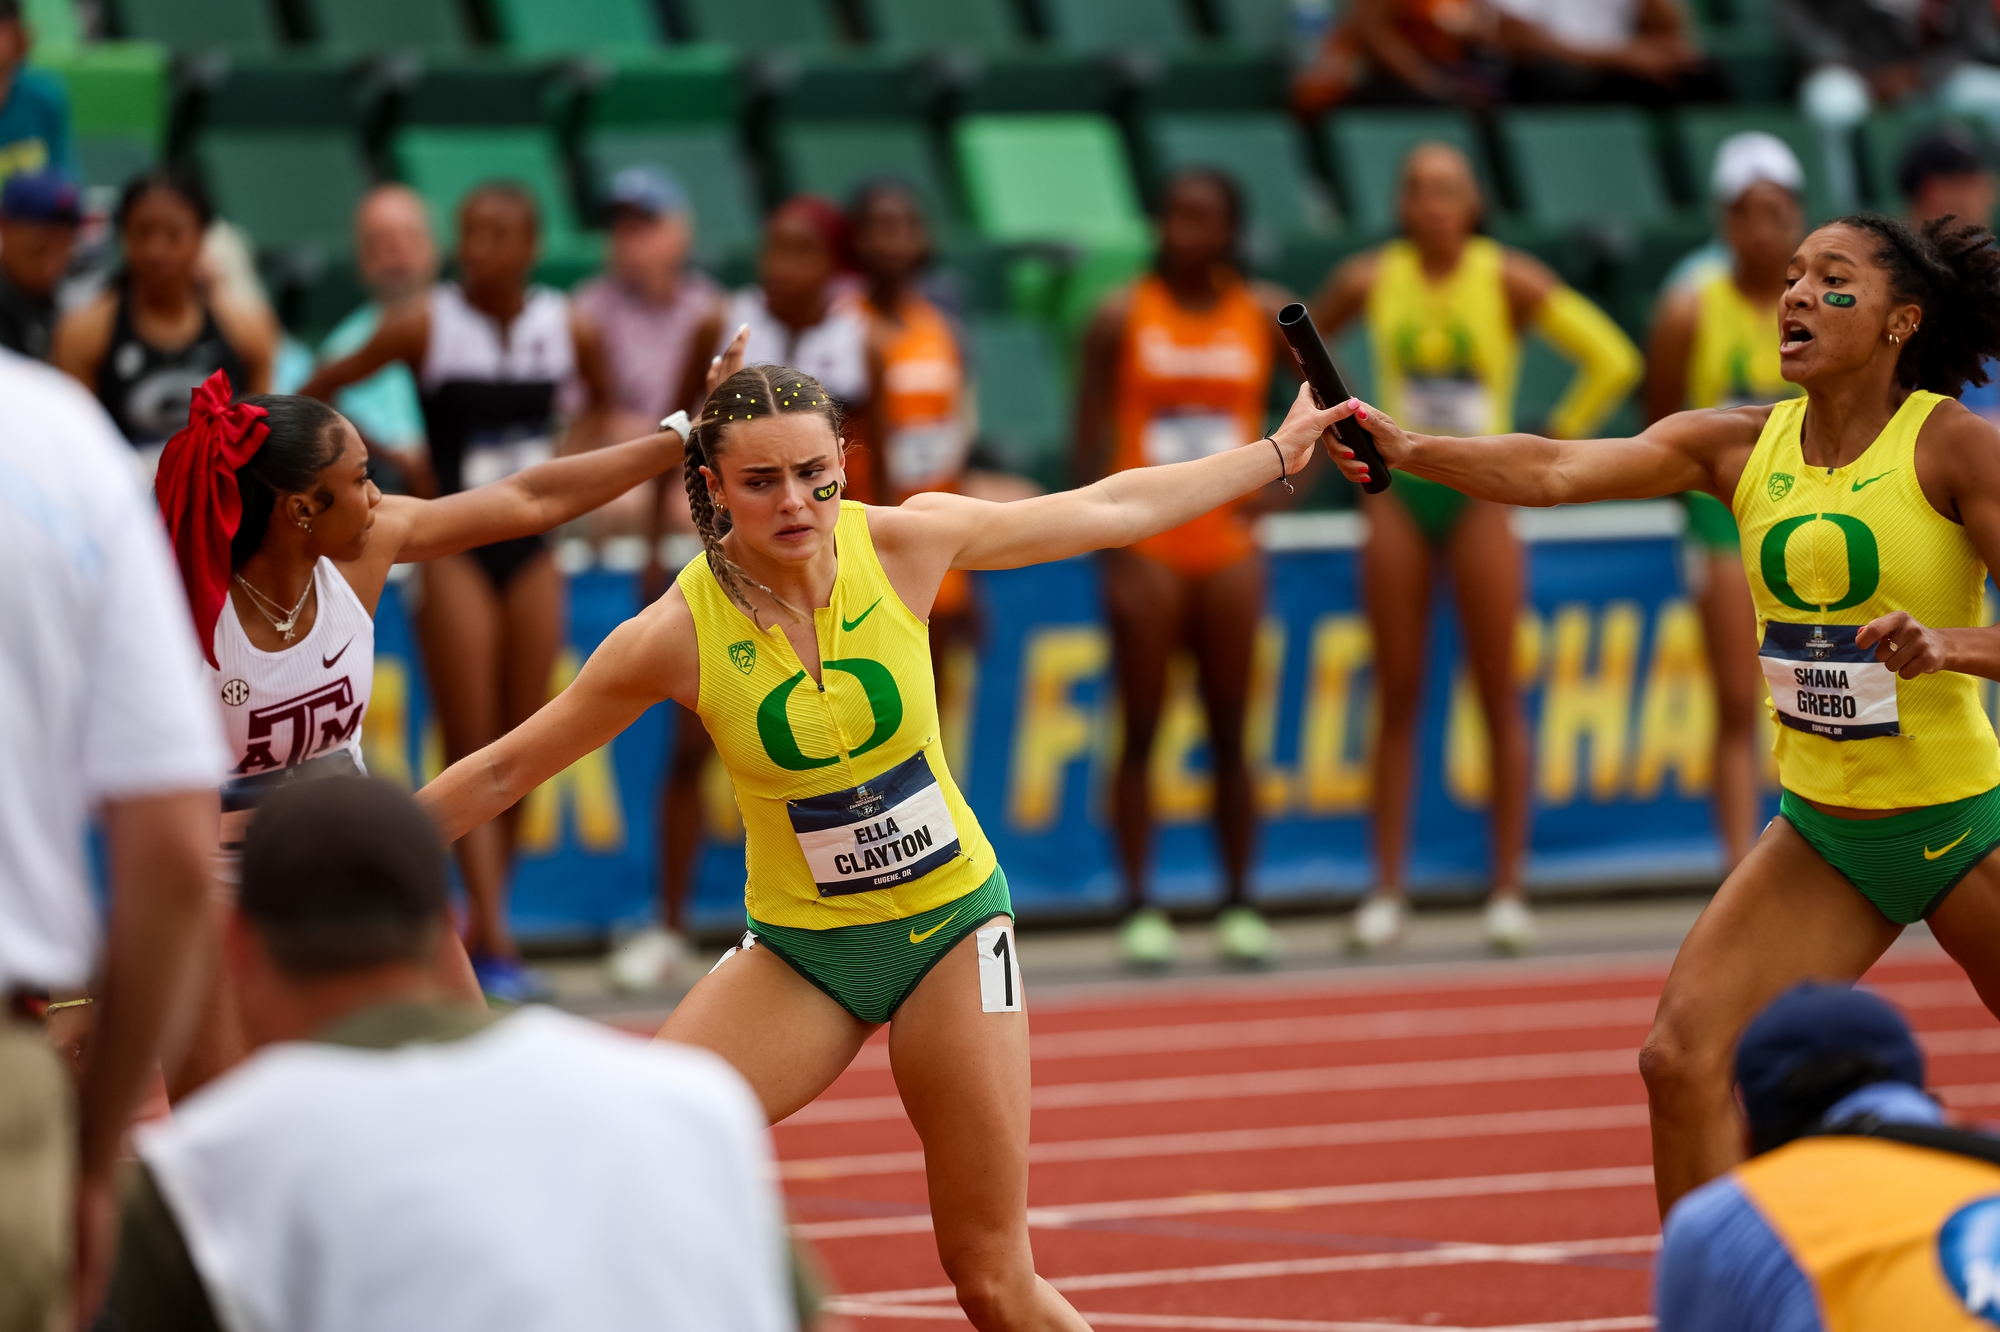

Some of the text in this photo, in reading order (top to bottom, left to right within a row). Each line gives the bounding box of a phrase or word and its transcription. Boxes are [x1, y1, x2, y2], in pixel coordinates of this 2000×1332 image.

[1769, 473, 1794, 491] PAC
[1771, 485, 1785, 497] 12
[1760, 512, 1879, 612] O
[729, 641, 755, 662] PAC
[738, 656, 752, 668] 12
[1794, 667, 1849, 689] SHANA
[222, 679, 249, 706] SEC
[1797, 690, 1857, 719] GREBO
[757, 658, 903, 771] O
[1833, 727, 1843, 735] OR
[853, 816, 900, 845] ELLA
[833, 824, 933, 875] CLAYTON
[873, 868, 913, 885] EUGENE, OR
[992, 931, 1014, 1007] 1
